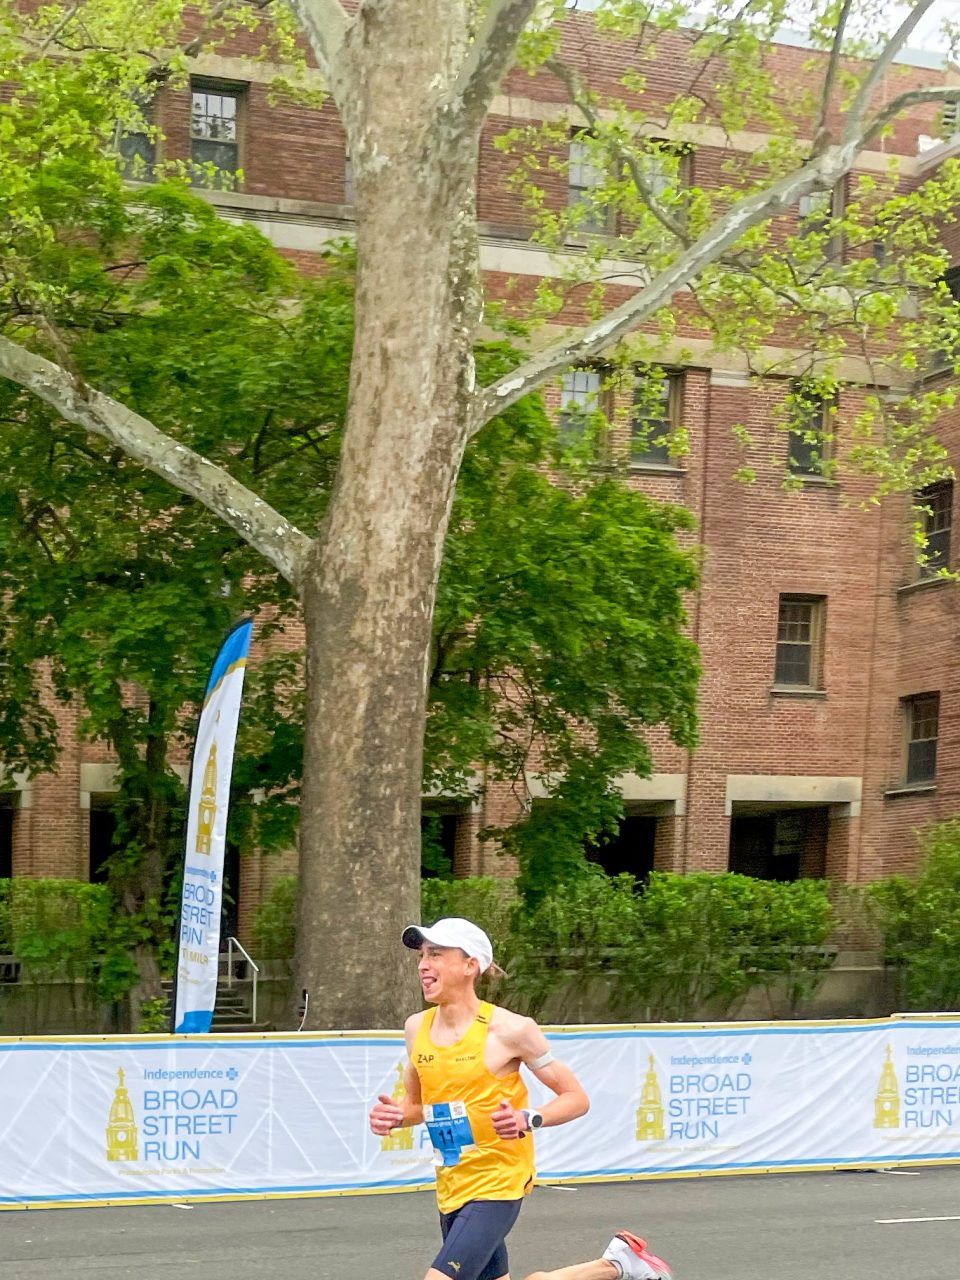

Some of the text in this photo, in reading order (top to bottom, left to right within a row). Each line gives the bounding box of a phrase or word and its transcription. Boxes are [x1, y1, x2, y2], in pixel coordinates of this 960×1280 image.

[417, 1054, 435, 1064] ZAP
[670, 1053, 739, 1067] Independence
[906, 1045, 960, 1056] Independen
[144, 1068, 223, 1081] Independence
[670, 1073, 752, 1094] BROAD
[906, 1064, 960, 1083] BROA
[144, 1089, 238, 1110] BROAD
[904, 1086, 960, 1106] STRE
[668, 1096, 752, 1117] STREET
[143, 1114, 238, 1136] STREET
[904, 1109, 953, 1129] RUN
[439, 1128, 455, 1147] 11
[669, 1120, 719, 1140] RUN
[144, 1140, 200, 1161] RUN
